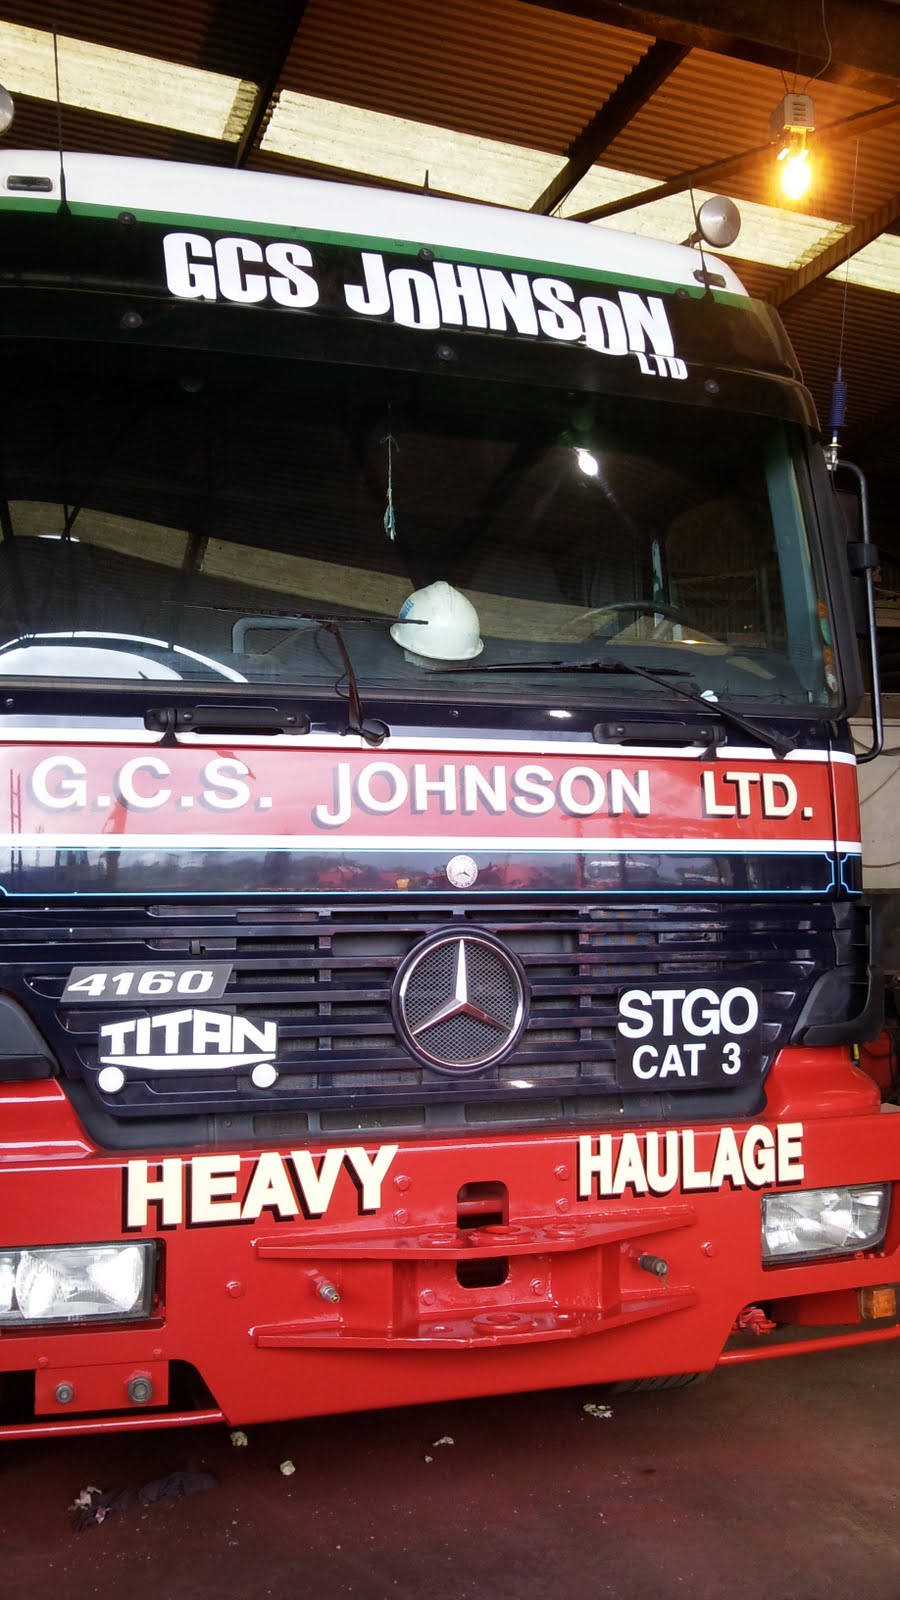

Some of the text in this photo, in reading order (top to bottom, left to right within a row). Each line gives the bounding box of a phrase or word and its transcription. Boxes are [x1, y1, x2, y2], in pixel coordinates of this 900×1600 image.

[163, 232, 319, 308] GCS
[634, 350, 688, 381] LTD
[31, 756, 813, 828] G.C.S. JOHNSON LTD.
[67, 969, 214, 996] 4160
[100, 1009, 277, 1055] TITAN
[617, 987, 759, 1039] STGO
[632, 1043, 741, 1080] CAT 3
[123, 1122, 805, 1231] HEAVY HAULAGE
